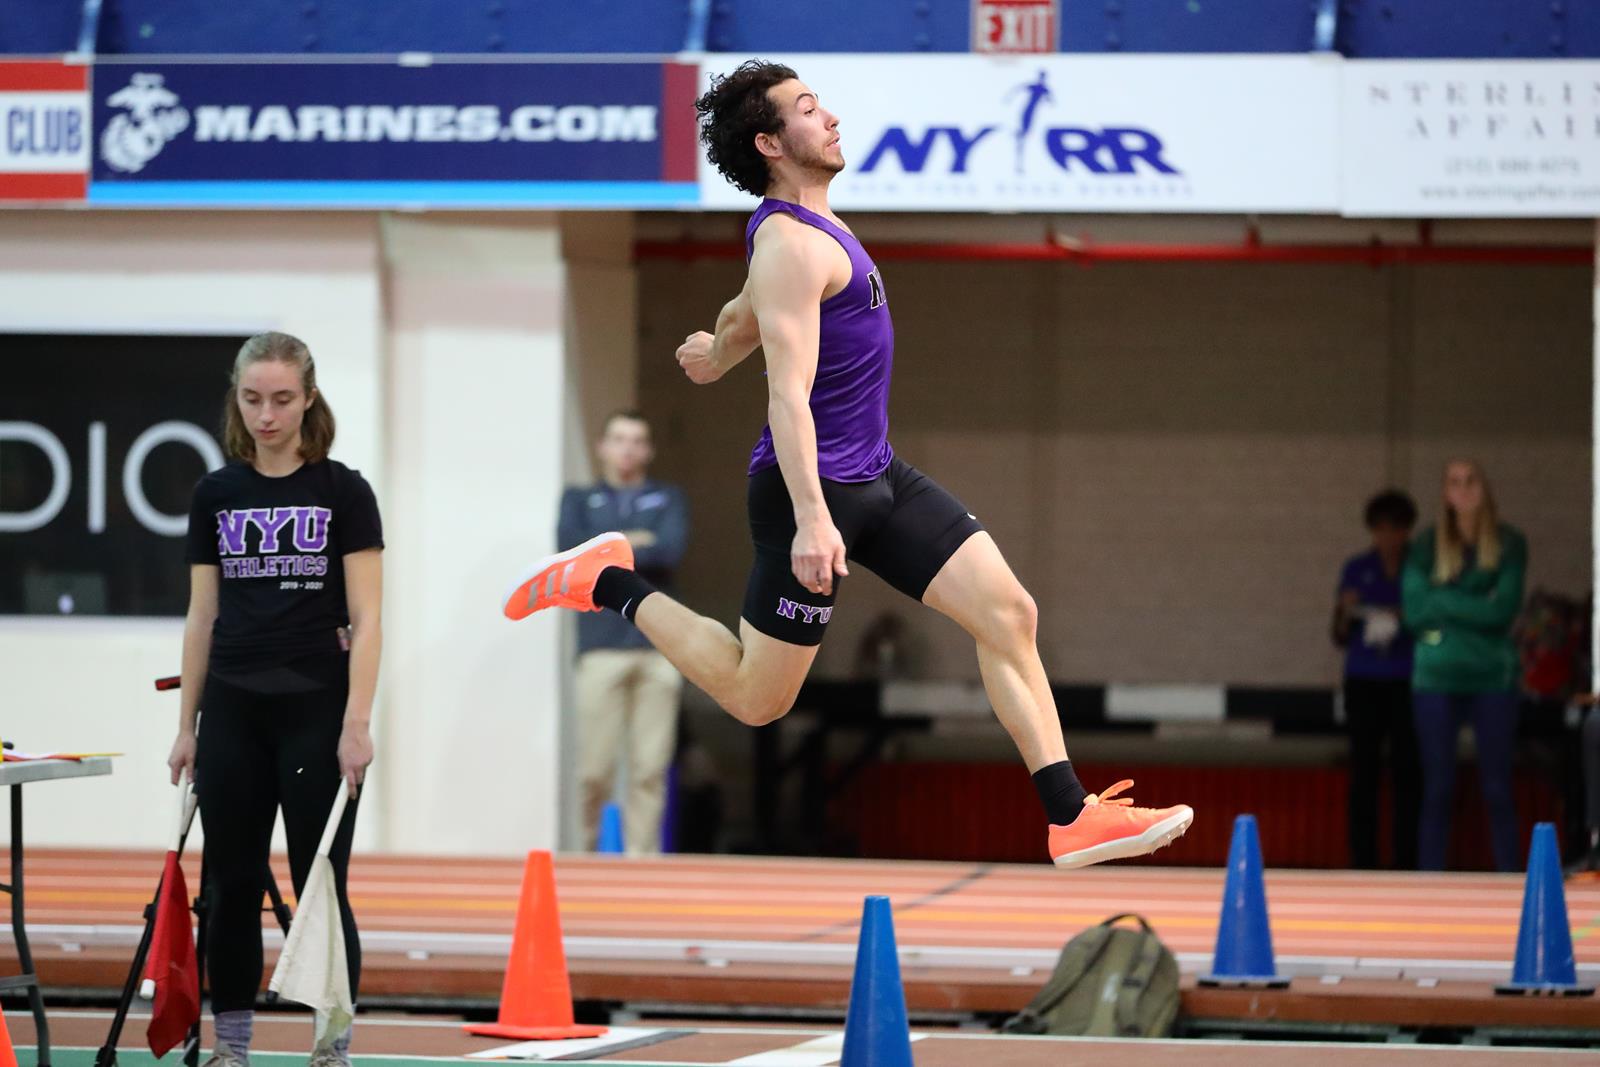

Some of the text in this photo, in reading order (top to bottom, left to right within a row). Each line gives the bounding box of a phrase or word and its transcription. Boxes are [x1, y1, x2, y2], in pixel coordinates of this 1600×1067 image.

[976, 5, 1055, 50] EXIT
[7, 107, 82, 155] CLUB
[194, 104, 657, 142] MARINES.COM
[216, 506, 332, 556] NYU
[221, 555, 328, 579] THLETICS
[776, 597, 833, 624] NYU
